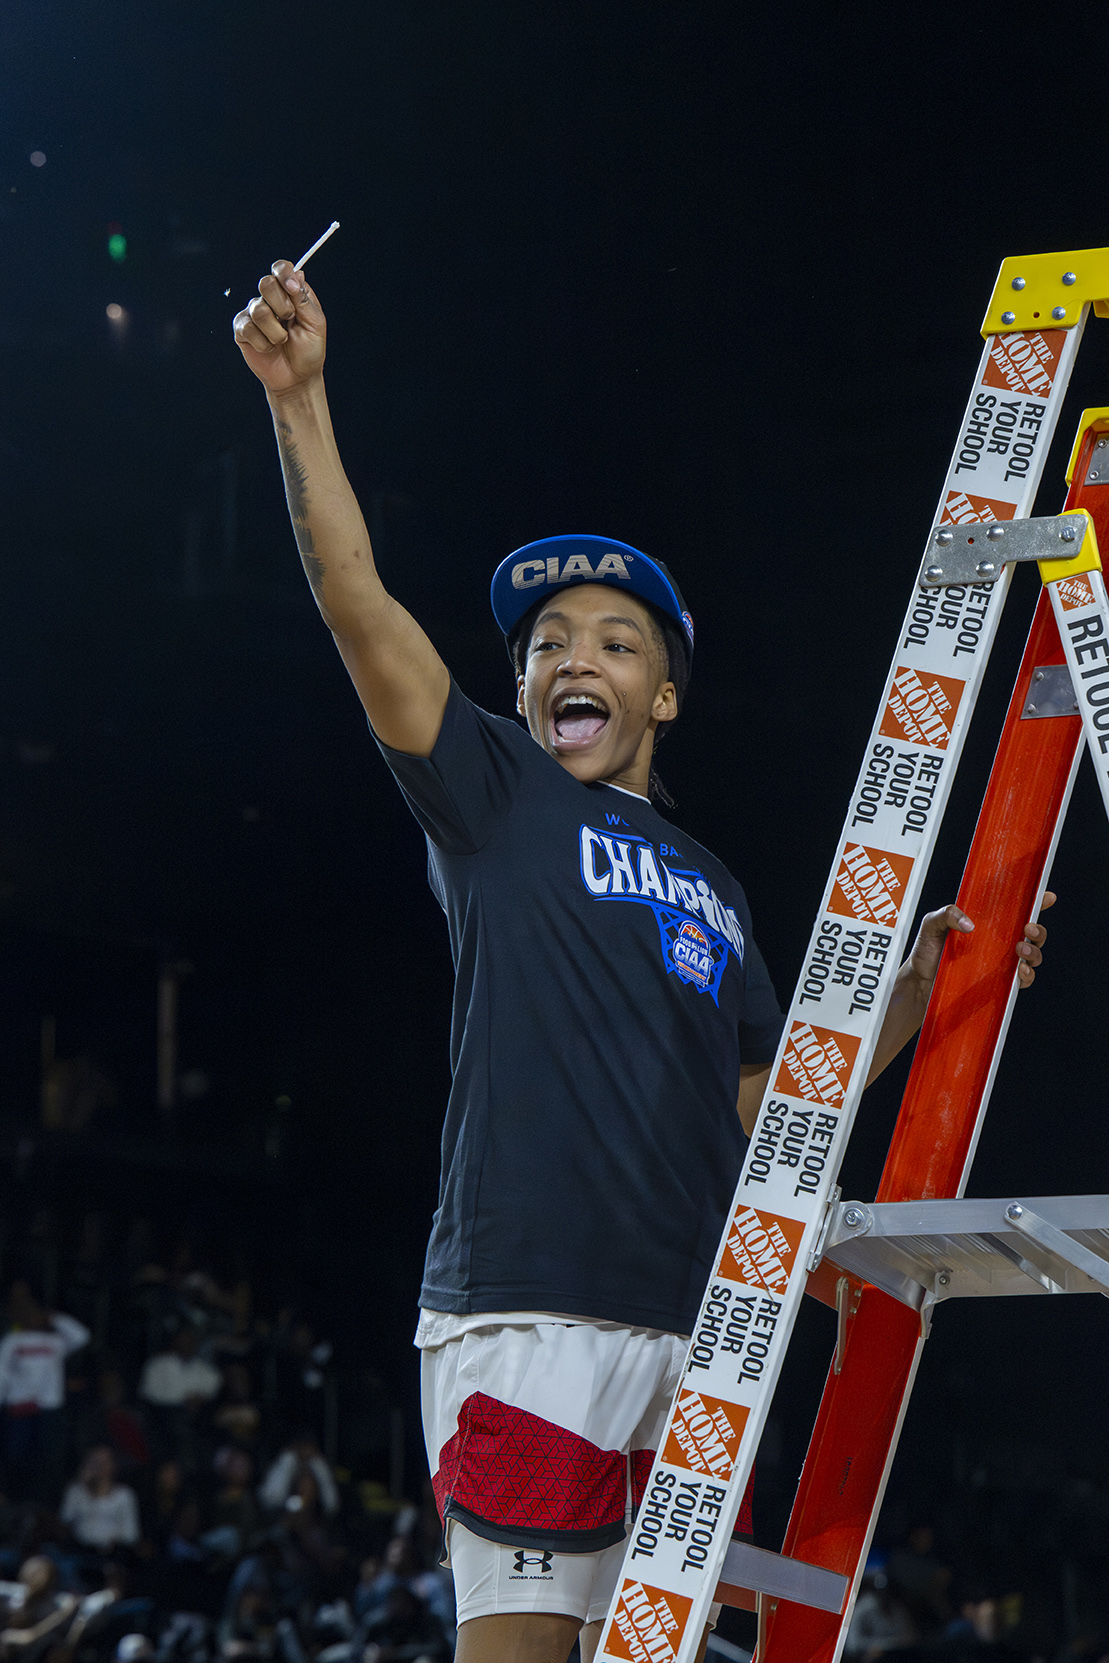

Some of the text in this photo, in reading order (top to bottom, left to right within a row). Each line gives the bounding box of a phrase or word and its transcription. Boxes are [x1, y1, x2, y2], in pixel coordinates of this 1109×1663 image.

[990, 345, 1025, 392] DEPOT
[1029, 332, 1054, 364] THE
[955, 393, 997, 474] SCHOOL
[987, 401, 1022, 455] YOUR
[1004, 402, 1046, 482] RETOOL
[511, 553, 632, 590] CIAA
[1057, 581, 1095, 604] HOME
[1073, 580, 1088, 590] THE
[903, 585, 942, 649] CHOOL
[935, 583, 969, 630] OUR
[1060, 593, 1085, 607] DEPOT
[888, 694, 924, 743] DEPOT
[894, 668, 951, 748] HOME
[927, 681, 952, 715] THE
[851, 743, 894, 827] SCHOOL
[884, 752, 920, 808] YOUR
[901, 753, 944, 836] RETOOL
[836, 870, 872, 920] DEPOT
[843, 844, 900, 926] HOME
[876, 858, 901, 892] THE
[674, 942, 710, 977] CIAA
[799, 920, 842, 1005] SCHOOL
[831, 930, 867, 986] YOUR
[848, 931, 892, 1015] RETOOL
[783, 1050, 819, 1100] DEPOT
[790, 1023, 847, 1107] HOME
[823, 1037, 848, 1072] THE
[744, 1100, 789, 1186] SCHOOL
[777, 1110, 814, 1168] YOUR
[794, 1112, 839, 1197] RETOOL
[727, 1234, 762, 1285] DEPOT
[734, 1207, 790, 1292] HOME
[767, 1222, 791, 1257] THE
[687, 1285, 732, 1373] SCHOOL
[720, 1296, 757, 1354] YOUR
[737, 1298, 782, 1384] RETOOL
[671, 1418, 706, 1471] DEPOT
[678, 1392, 735, 1479] HOME
[711, 1406, 736, 1442] THE
[631, 1470, 676, 1560] SCHOOL
[664, 1482, 702, 1542] YOUR
[681, 1485, 727, 1572] RETOOL
[613, 1609, 649, 1663] DEPOT
[654, 1597, 679, 1634] THE
